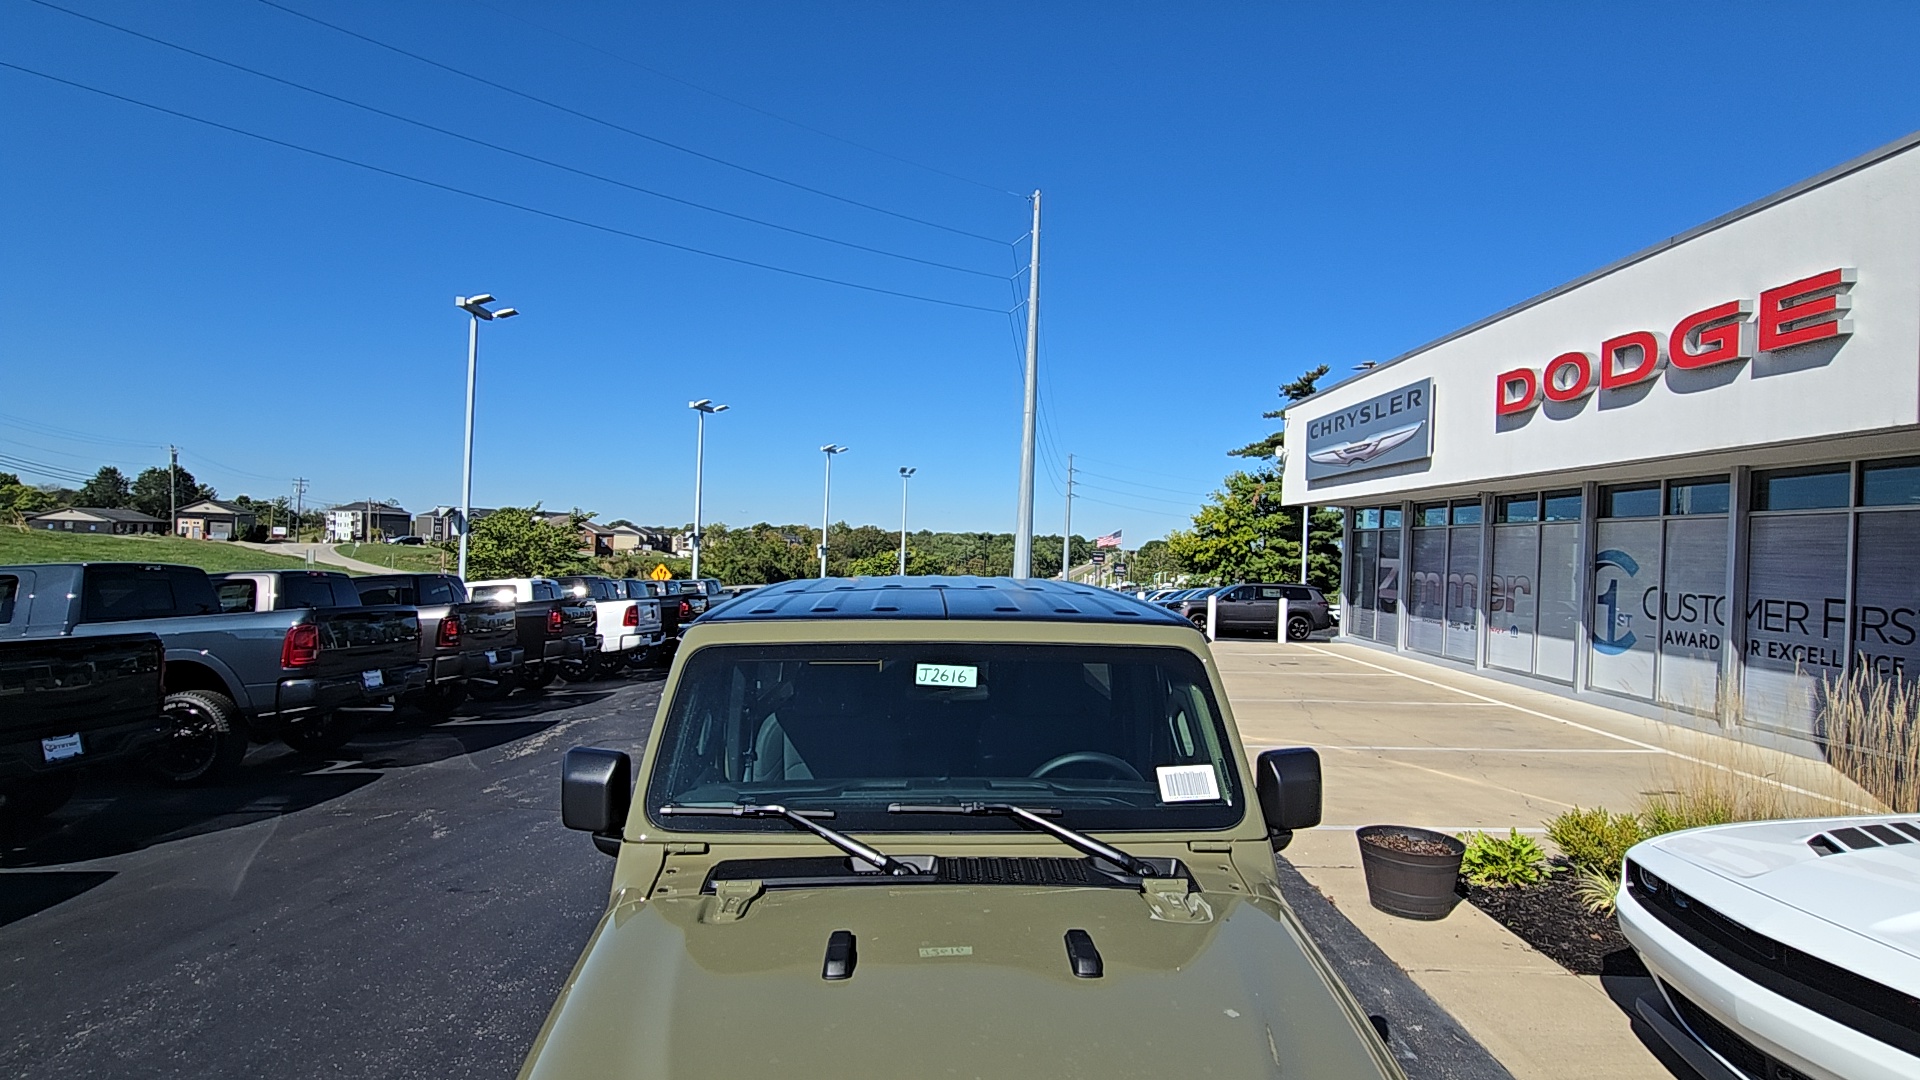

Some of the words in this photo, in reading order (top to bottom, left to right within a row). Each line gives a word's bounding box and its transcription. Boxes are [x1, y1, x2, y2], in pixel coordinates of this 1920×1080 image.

[1496, 268, 1854, 415] DODGE
[1310, 389, 1422, 439] CHRYSLER
[1379, 558, 1531, 613] Zmmer
[1823, 598, 1920, 646] FIRS
[919, 668, 967, 683] J2616
[1664, 630, 1720, 650] AWARD
[1767, 642, 1905, 676] EXCELLNCE
